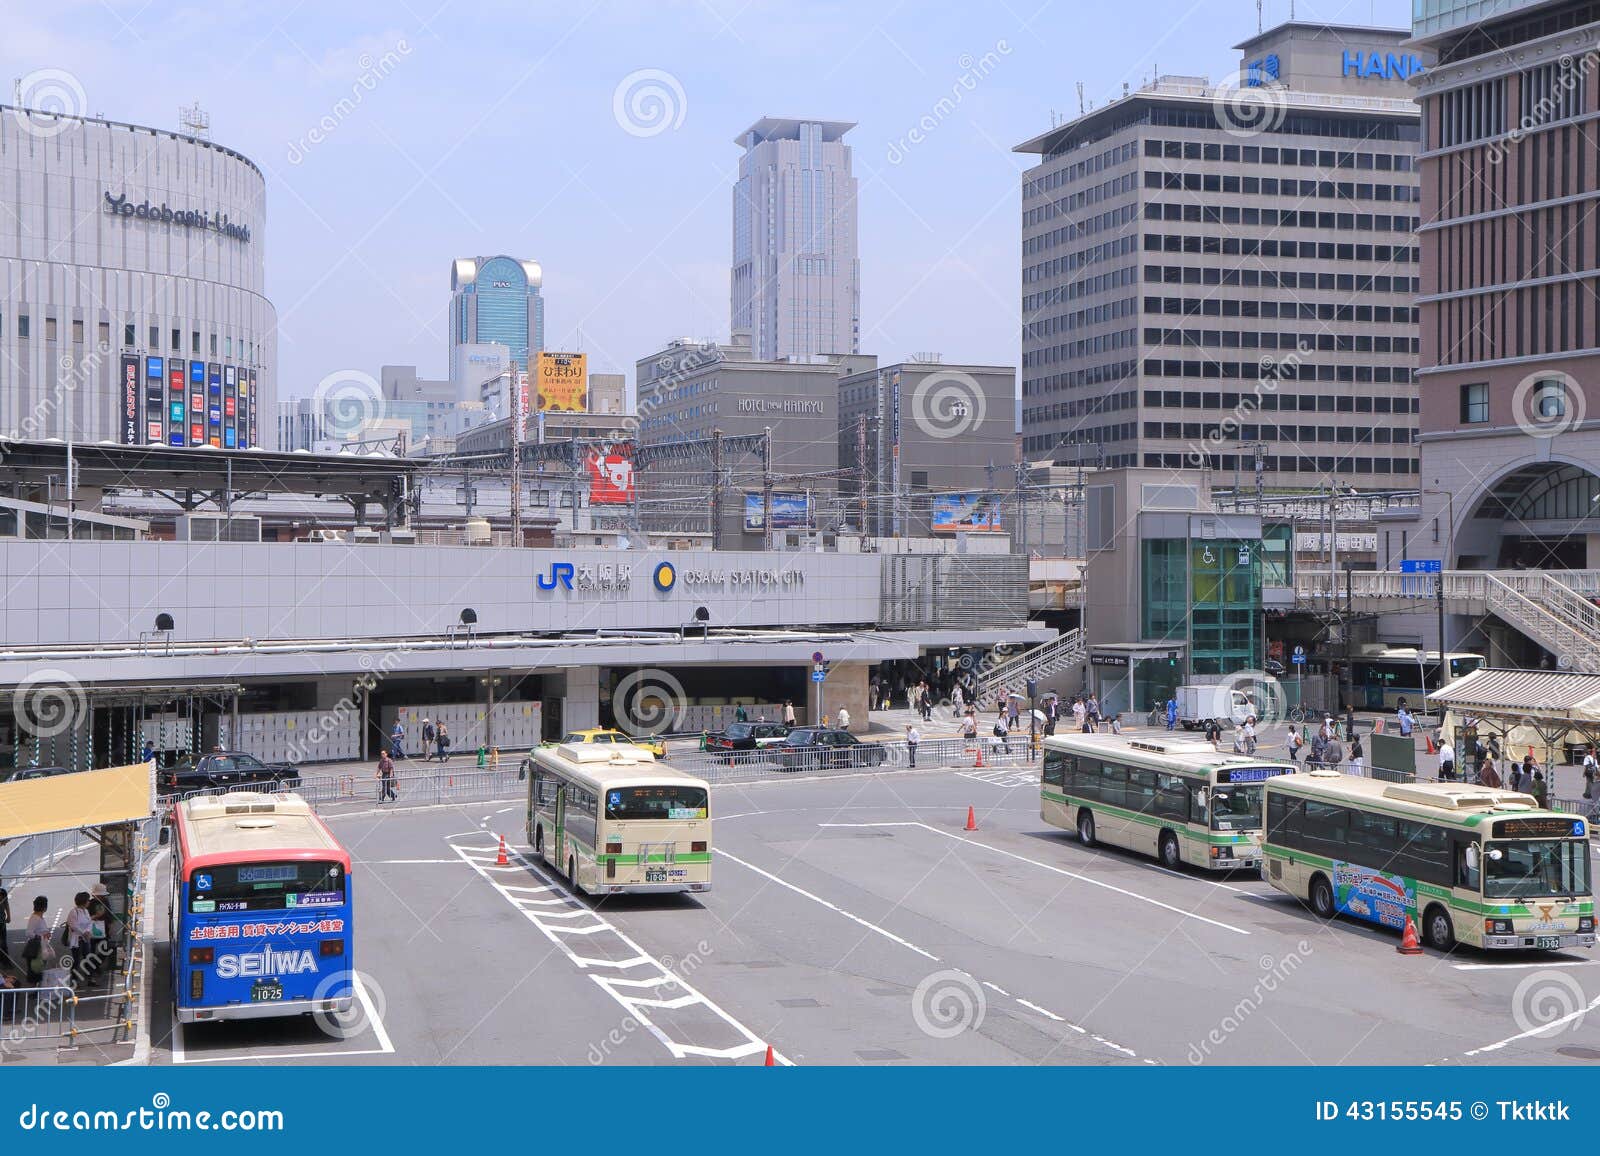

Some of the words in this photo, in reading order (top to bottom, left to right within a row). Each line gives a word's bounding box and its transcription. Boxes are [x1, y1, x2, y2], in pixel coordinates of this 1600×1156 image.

[544, 366, 582, 378] ひまわり
[738, 399, 767, 412] HOTEL
[768, 401, 782, 410] new
[784, 401, 824, 414] HANKYU
[537, 562, 574, 591] JR
[578, 563, 632, 581] 大阪駅
[686, 569, 725, 585] OSAKA
[731, 569, 779, 585] STATION
[782, 570, 807, 585] CITY
[190, 925, 240, 941] 土地活用
[243, 920, 344, 938] 賃貸マンション経営
[257, 988, 282, 1000] 10-25
